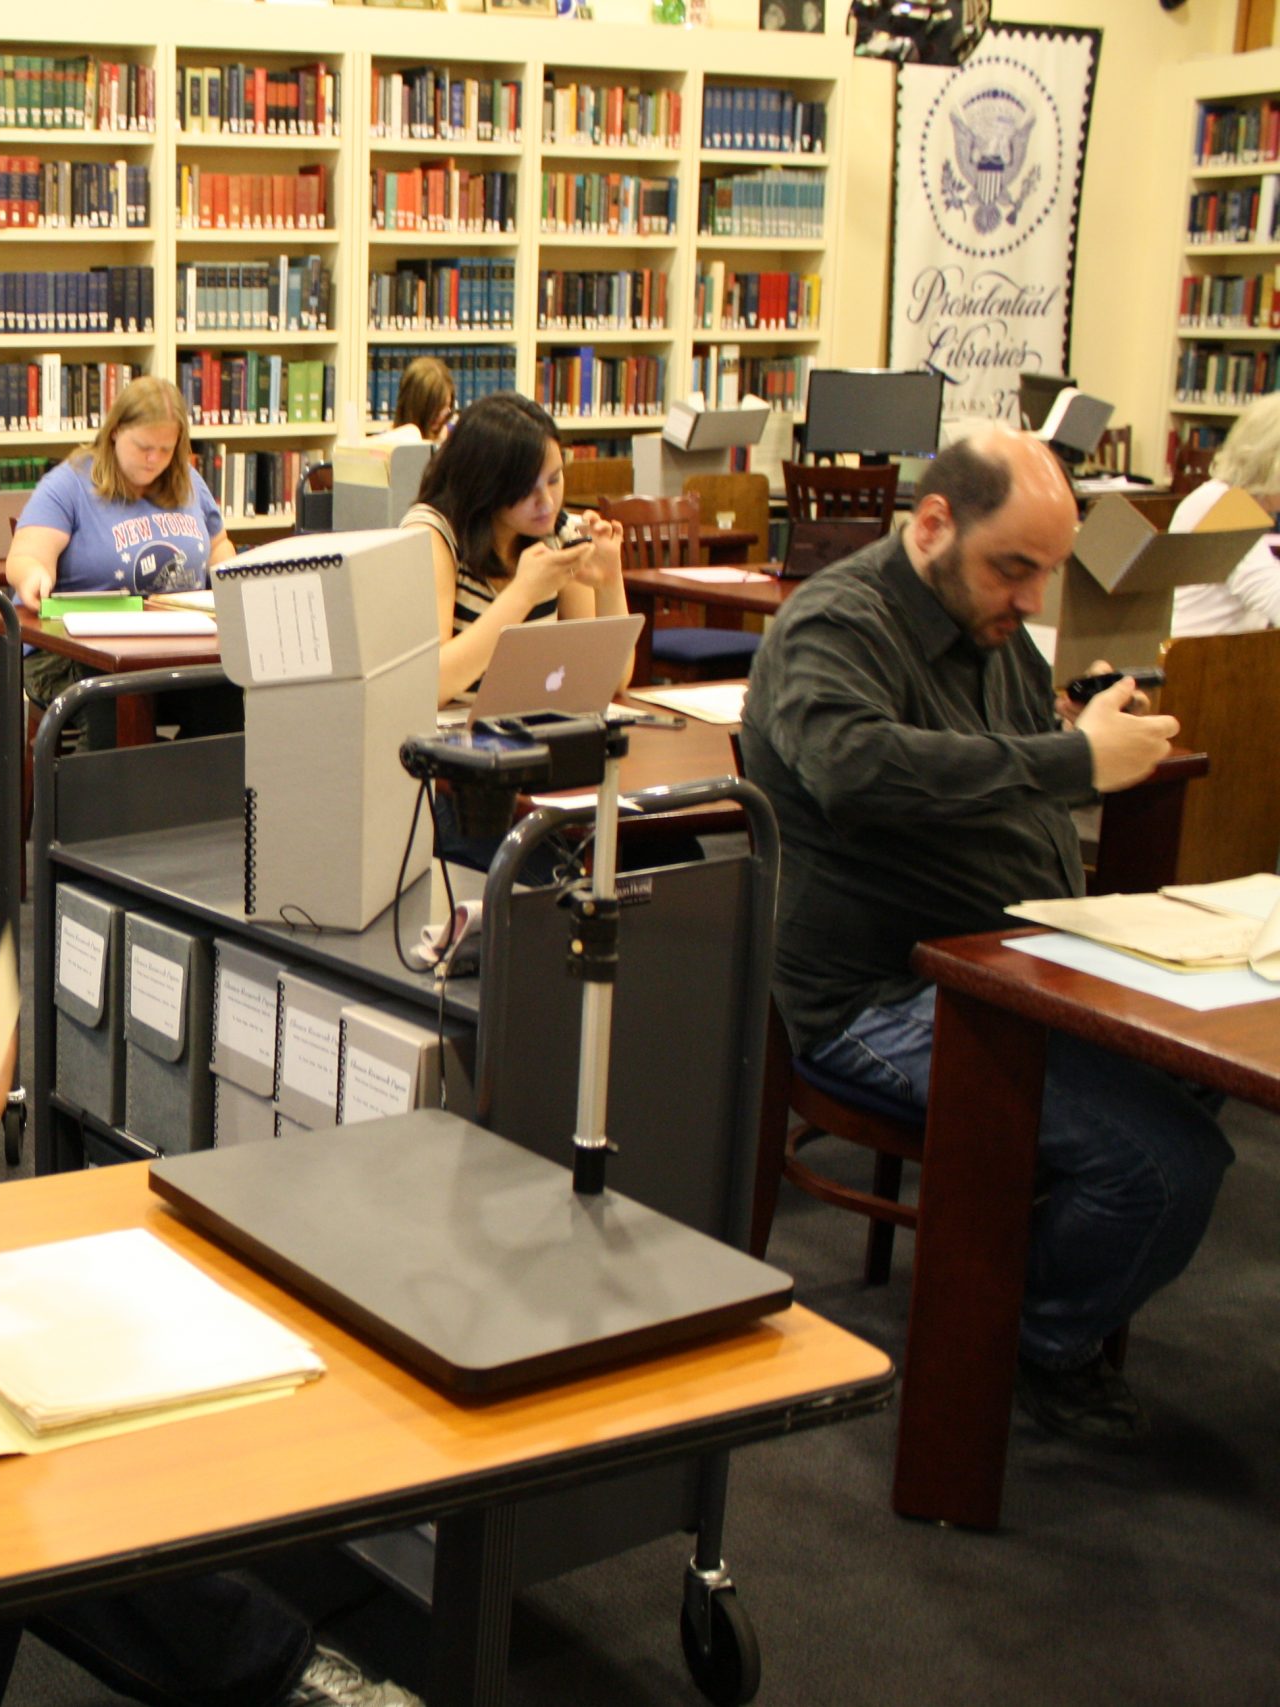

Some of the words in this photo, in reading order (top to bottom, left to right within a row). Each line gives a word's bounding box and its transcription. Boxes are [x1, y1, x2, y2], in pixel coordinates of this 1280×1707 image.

[907, 264, 1060, 324] Presidential
[920, 318, 1043, 386] Libraries
[112, 515, 153, 553] NEW
[151, 512, 204, 542] YORK
